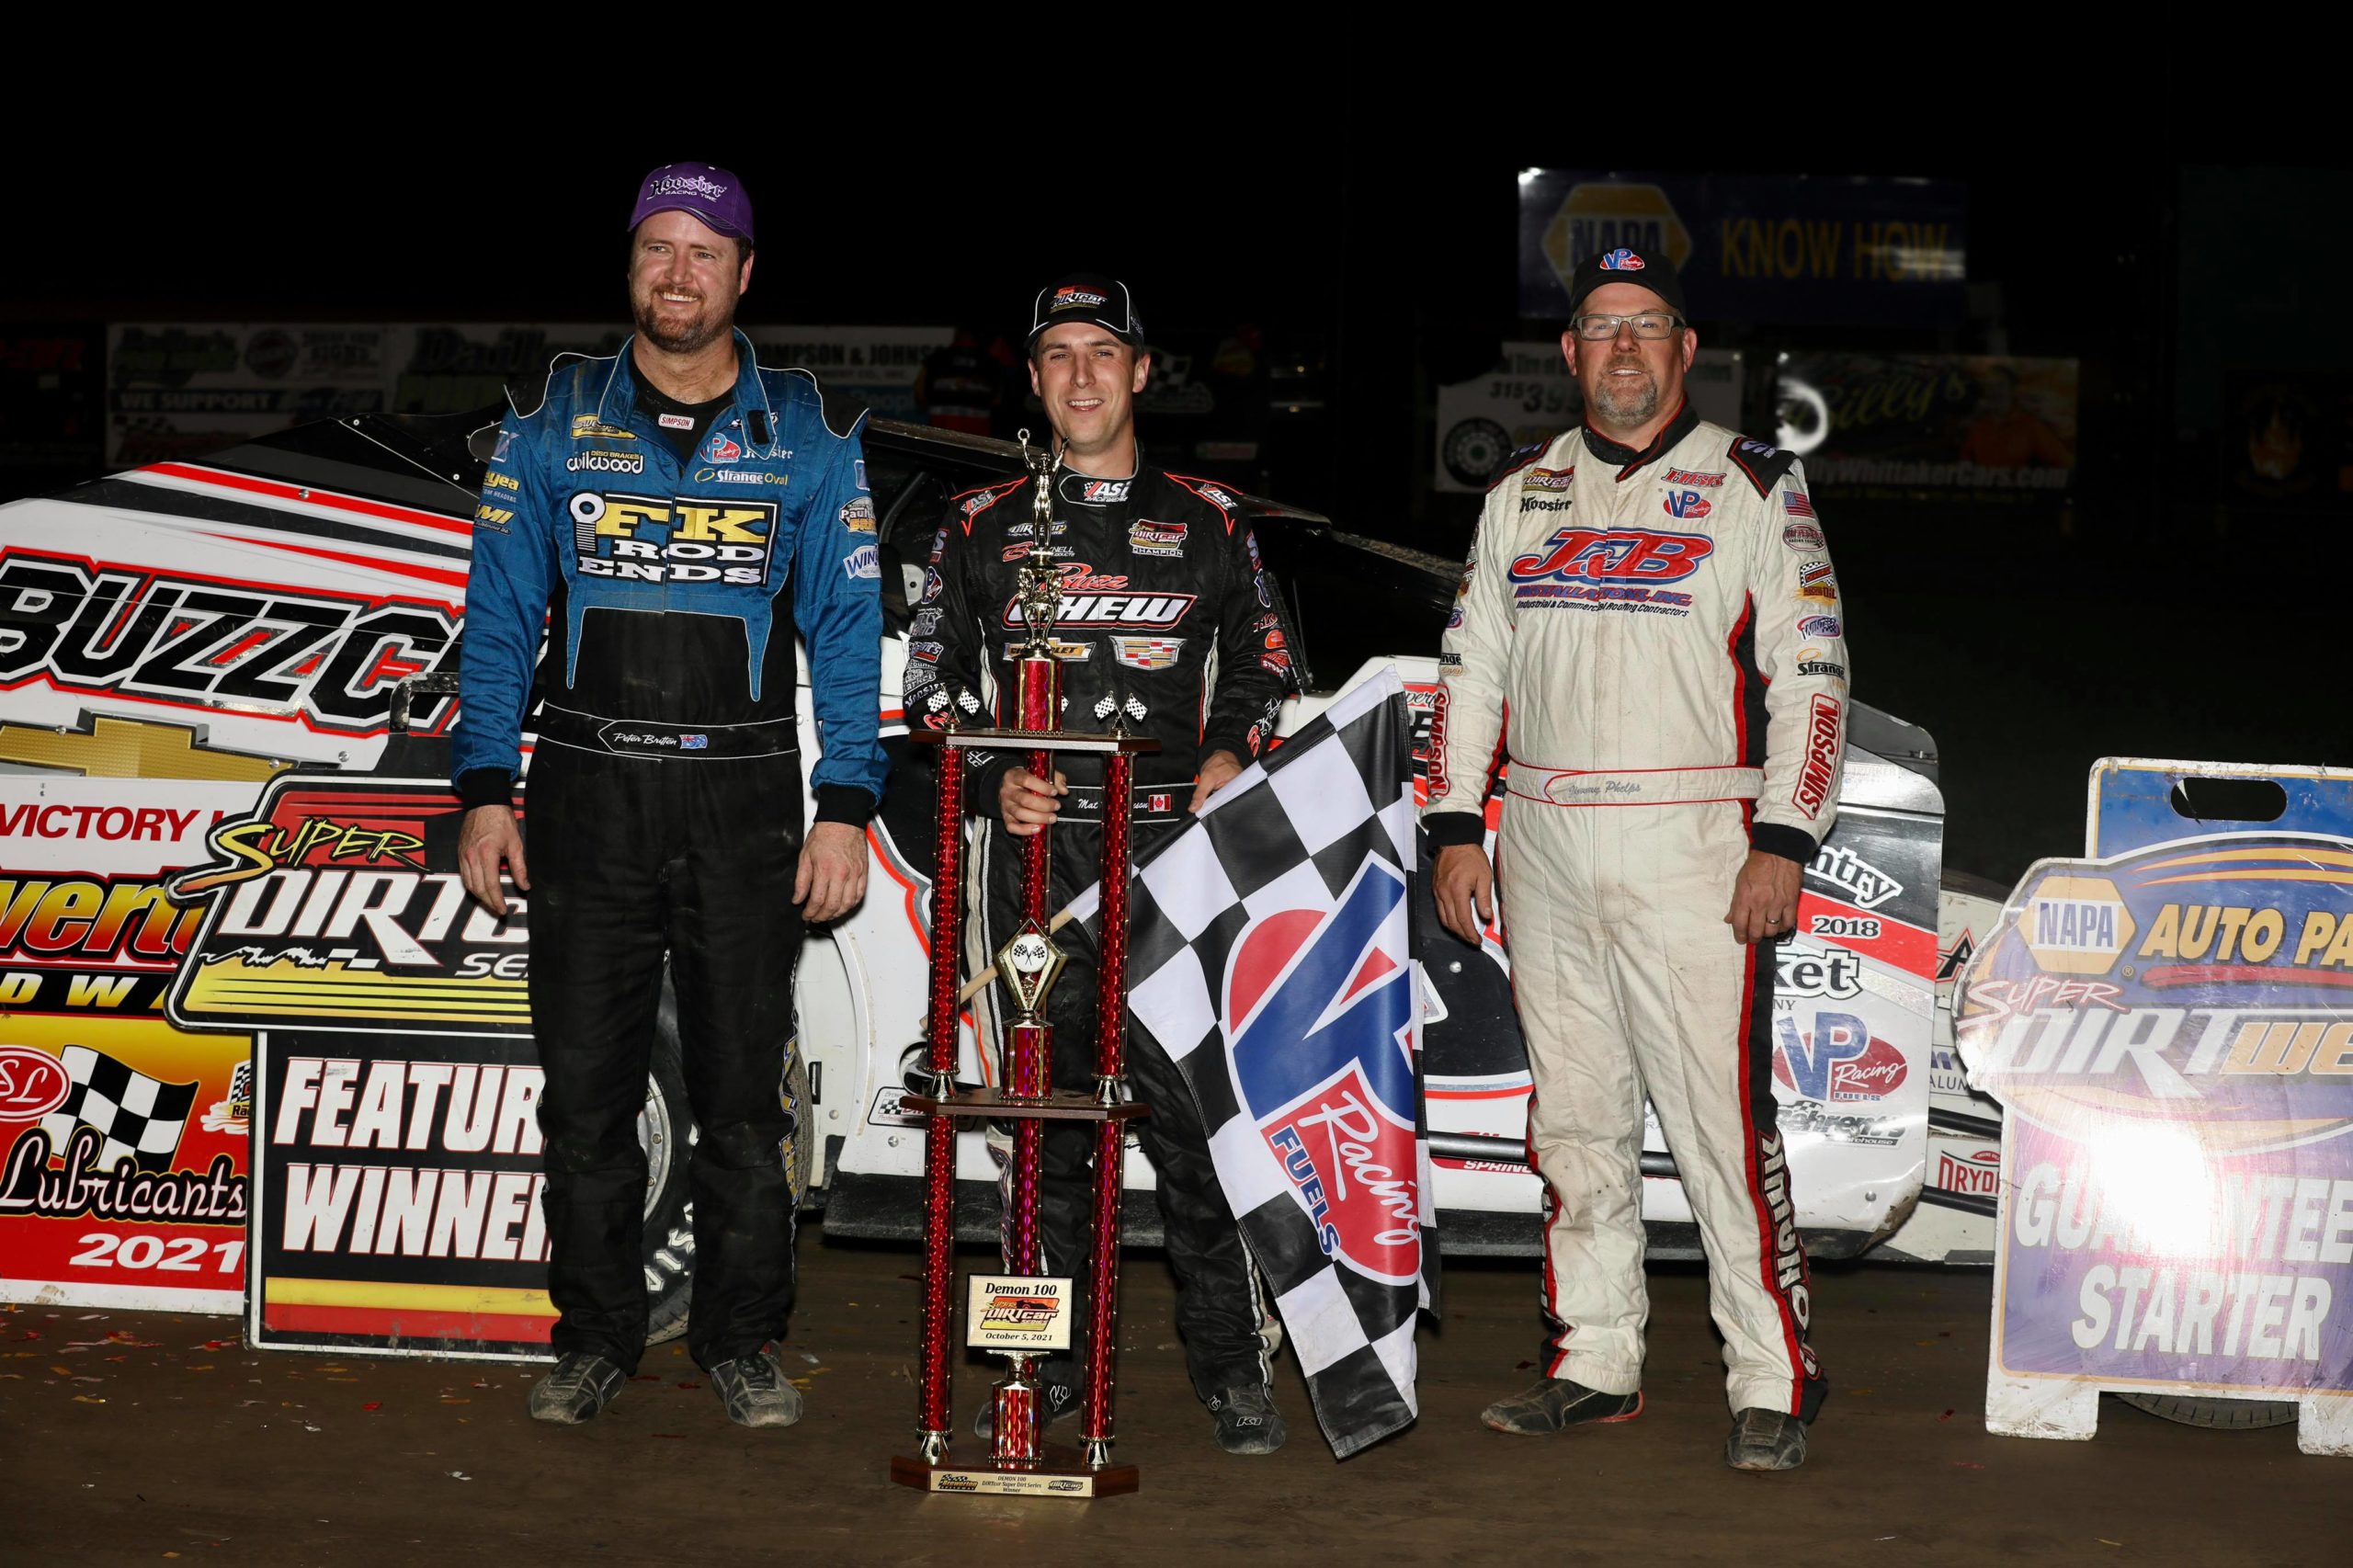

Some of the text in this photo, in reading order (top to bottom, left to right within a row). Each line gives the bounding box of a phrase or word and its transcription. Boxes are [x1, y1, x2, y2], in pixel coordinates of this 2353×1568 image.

[1603, 248, 1633, 269] VP
[1721, 217, 1950, 281] KNOW HOW
[661, 416, 692, 427] SIMPSON
[566, 450, 644, 475] wilwood
[609, 451, 641, 460] BRAKES
[716, 468, 789, 486] Strange Oval
[1519, 496, 1573, 513] Hoosier
[1667, 490, 1701, 518] VP
[596, 499, 767, 545] FK
[612, 539, 766, 562] ROD
[1131, 547, 1185, 557] CHAMPION
[578, 558, 762, 585] ENDS
[1516, 600, 1552, 609] Industrial
[1607, 602, 1637, 613] Roofing
[1637, 604, 1690, 618] Contractors
[0, 557, 465, 726] BUZZC
[613, 733, 642, 744] Peter
[1800, 701, 1839, 814] SIMPSON
[1605, 780, 1642, 794] Phelps
[1077, 798, 1099, 810] Mat
[0, 803, 201, 843] VICTORY
[176, 817, 431, 892] SUPER
[1813, 916, 1880, 937] 2018
[2038, 902, 2114, 949] NAPA
[2135, 903, 2285, 965] AUTO
[1955, 976, 2131, 1030] SUPER
[1777, 1011, 1869, 1102] VP
[1834, 1060, 1907, 1091] Racing
[273, 1056, 547, 1155] FEATUR
[0, 1135, 246, 1219] Lubricants
[1297, 1089, 1421, 1246] Racing
[1269, 1124, 1342, 1256] FUELS
[69, 1233, 245, 1274] 2021
[985, 1282, 1058, 1296] Demon 100
[2072, 1263, 2332, 1361] STARTER
[985, 1332, 1053, 1342] October 5, 2021
